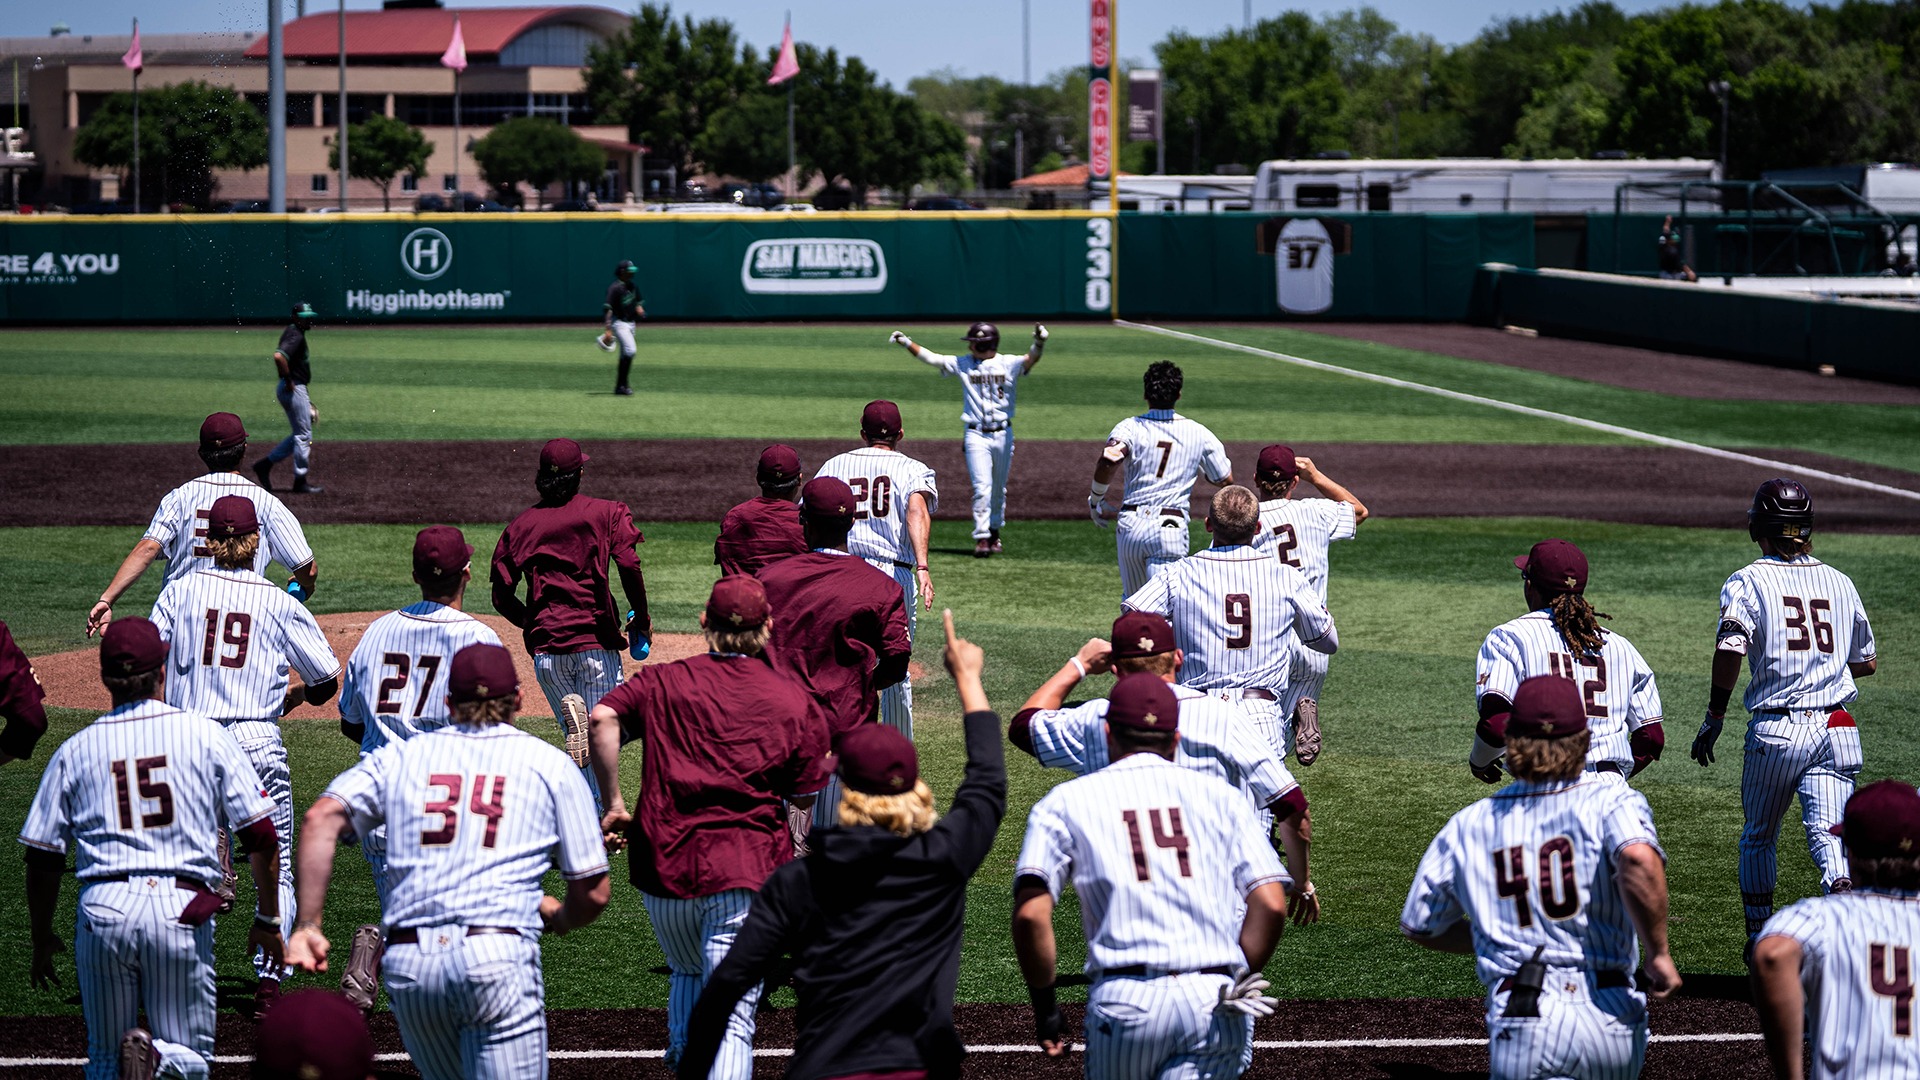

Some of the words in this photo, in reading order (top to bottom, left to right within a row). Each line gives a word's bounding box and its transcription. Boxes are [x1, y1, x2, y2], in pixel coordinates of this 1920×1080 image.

[32, 251, 54, 275] 4
[61, 253, 119, 275] YOU
[755, 245, 795, 269] SAN
[797, 244, 874, 269] MARCOS
[1085, 217, 1111, 311] 330
[1288, 243, 1320, 270] 37
[346, 288, 505, 315] Higginbotham
[1156, 440, 1173, 479] 7
[848, 475, 891, 521] 20
[1272, 523, 1302, 569] 2
[202, 607, 252, 670] 19
[1225, 592, 1252, 650] 9
[1782, 595, 1834, 655] 36
[375, 651, 442, 718] 27
[111, 754, 175, 831] 15
[420, 773, 506, 850] 34
[1122, 807, 1192, 882] 14
[1492, 835, 1581, 929] 40
[1869, 942, 1914, 1037] 4
